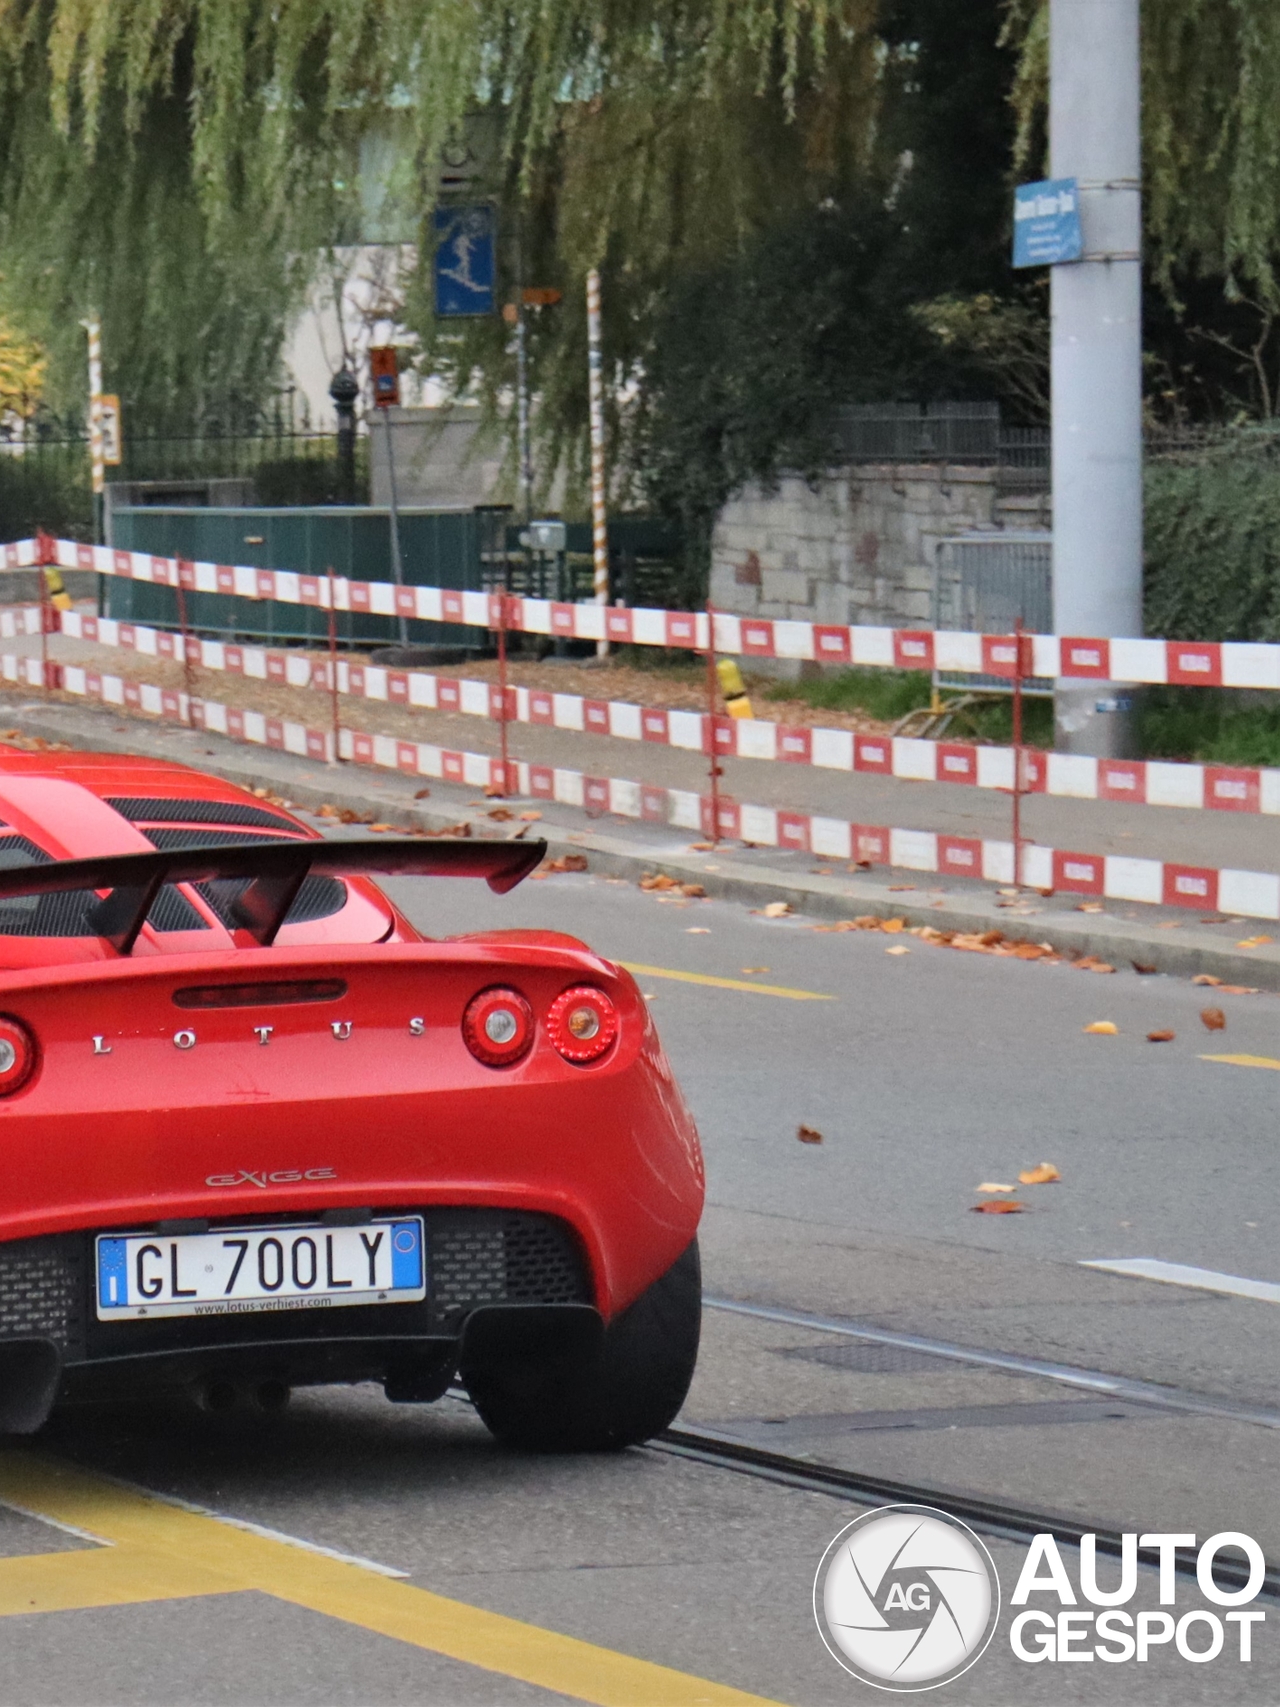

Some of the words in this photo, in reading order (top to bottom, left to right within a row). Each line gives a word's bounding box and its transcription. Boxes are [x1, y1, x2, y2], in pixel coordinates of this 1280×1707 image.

[93, 1017, 426, 1055] LOTUS
[205, 1167, 338, 1188] EXIGE
[136, 1244, 197, 1298] GL
[222, 1231, 385, 1294] 700LY
[194, 1297, 332, 1315] www.lotus-verhiest.com
